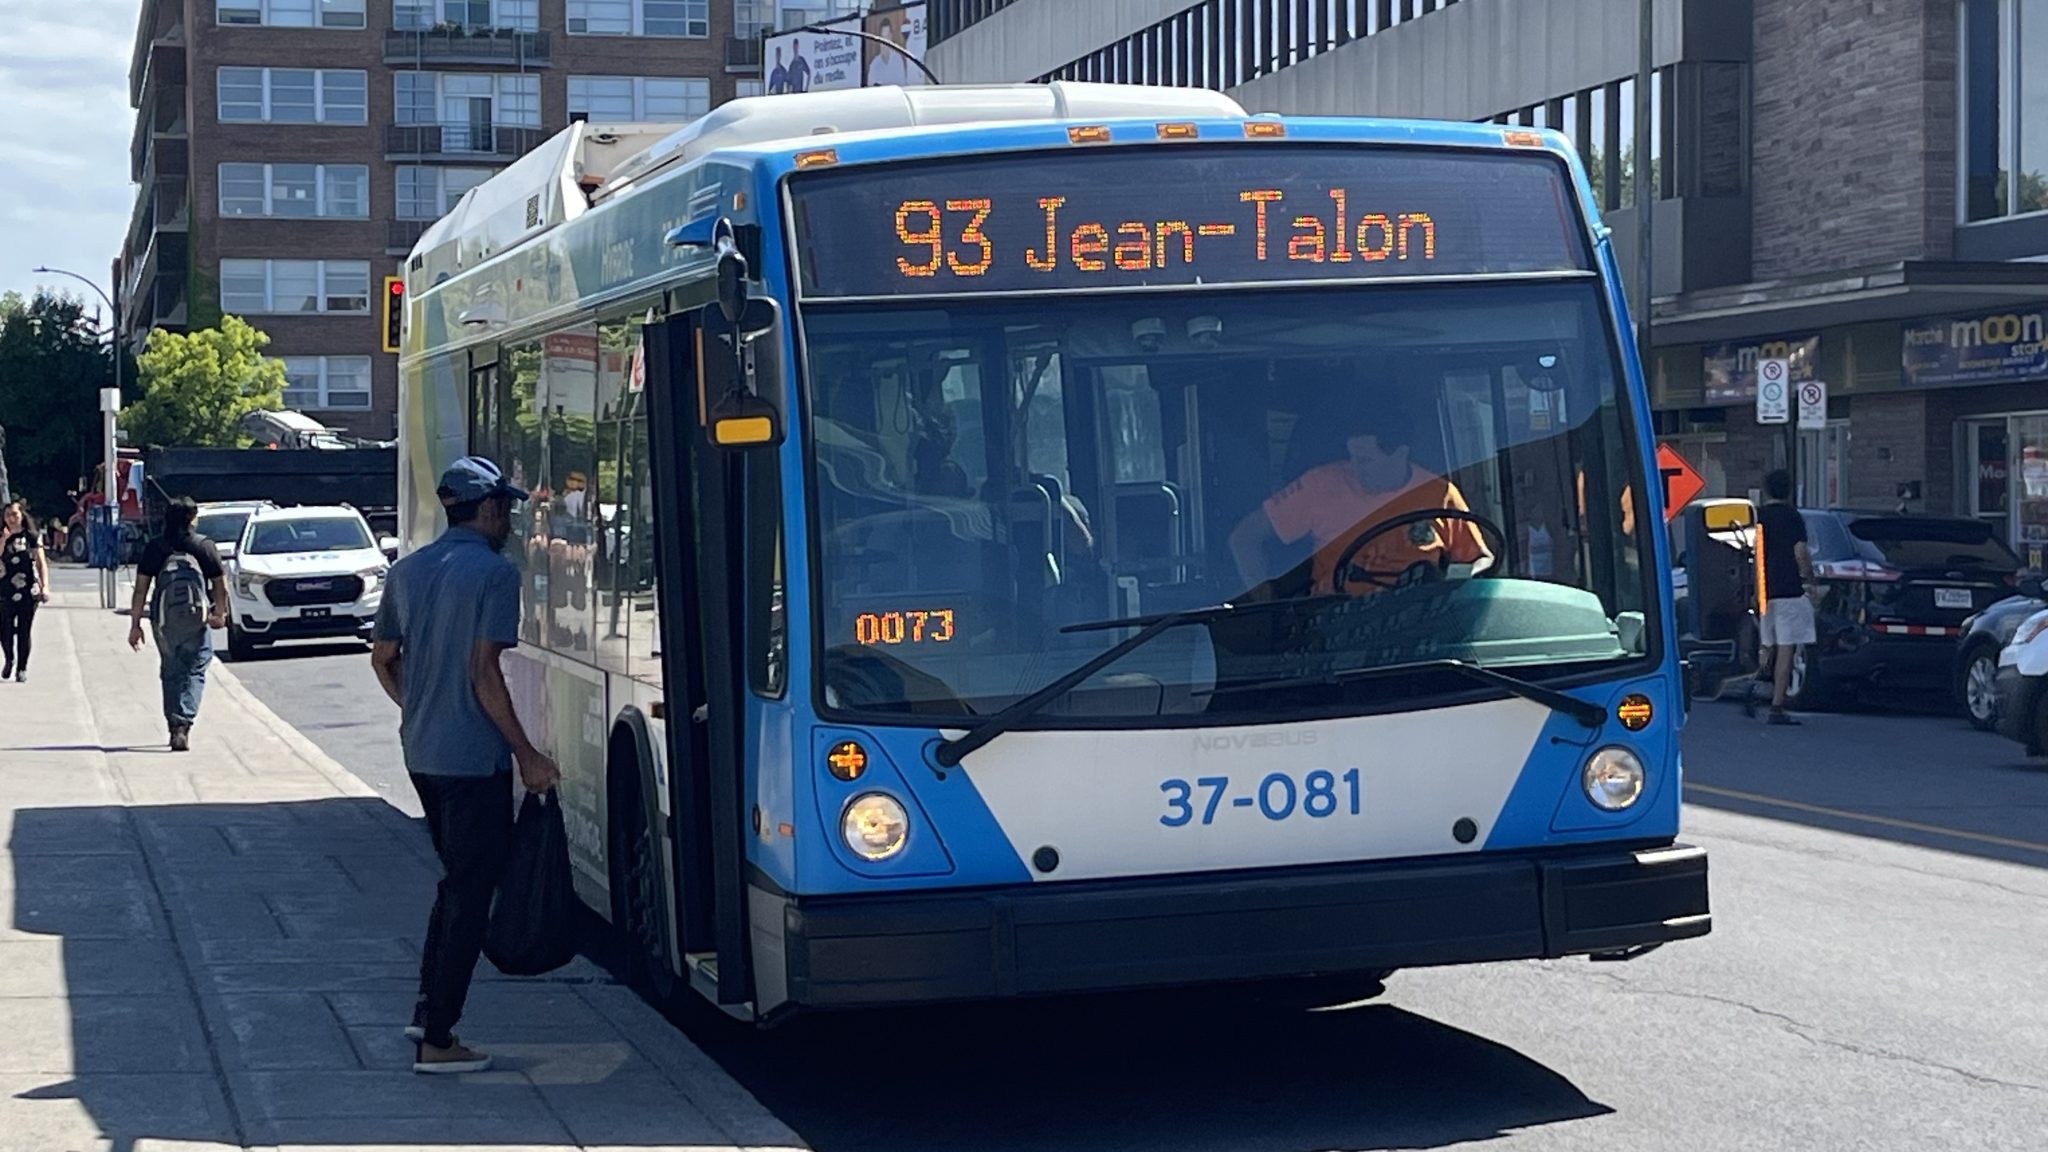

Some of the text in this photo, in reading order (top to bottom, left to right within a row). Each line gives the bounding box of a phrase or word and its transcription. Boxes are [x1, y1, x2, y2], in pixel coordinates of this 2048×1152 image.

[896, 188, 1436, 276] 93 Jean-Talon
[1951, 314, 2043, 349] moon
[2011, 342, 2041, 357] star
[855, 609, 954, 645] 0073
[1159, 768, 1361, 828] 37-081
